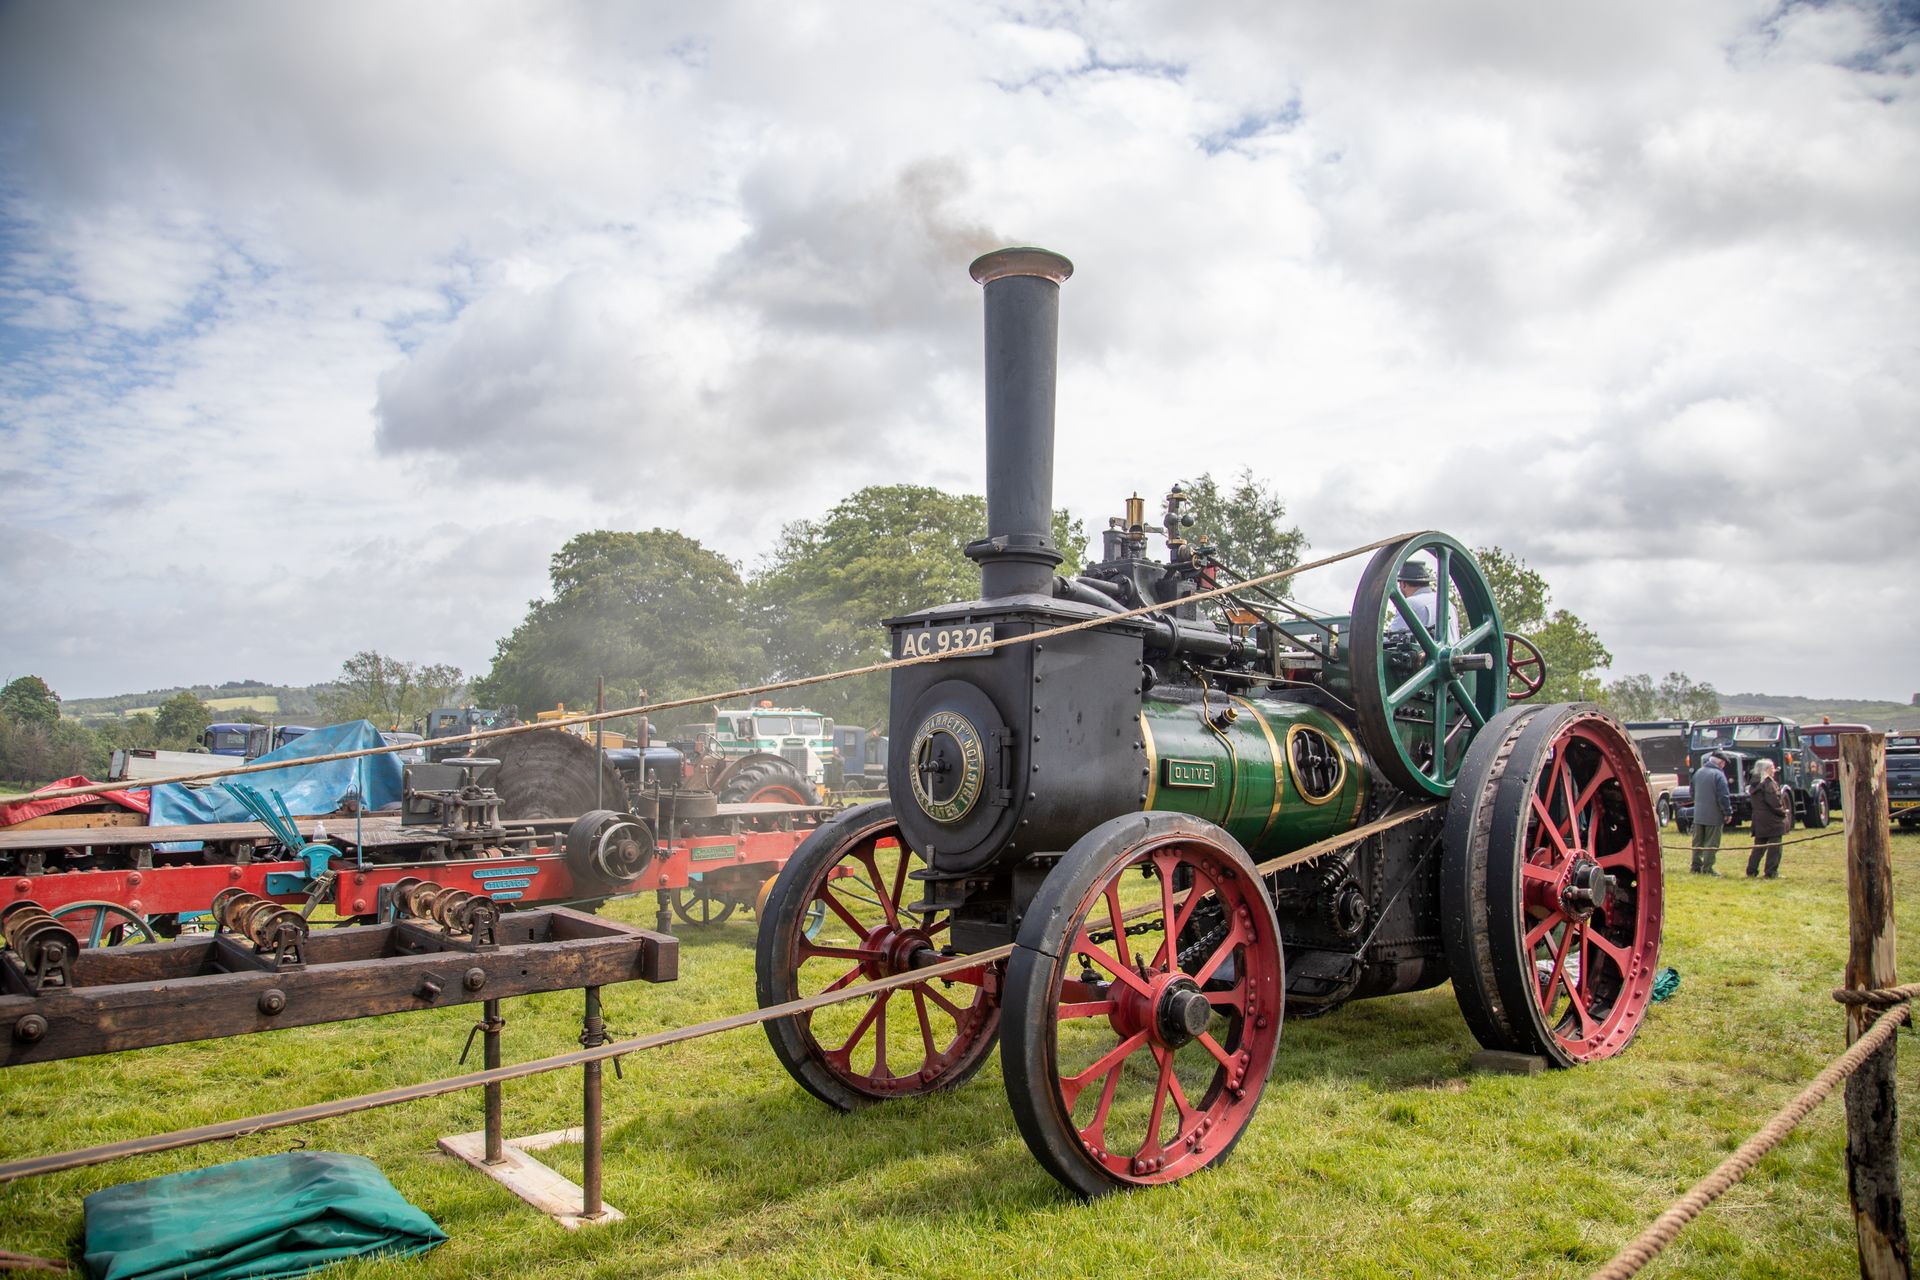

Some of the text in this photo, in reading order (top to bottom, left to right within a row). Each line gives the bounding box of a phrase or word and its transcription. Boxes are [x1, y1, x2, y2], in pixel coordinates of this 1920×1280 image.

[902, 626, 992, 657] AC 9326
[1708, 715, 1765, 725] CHERRY BLOSSOM
[1175, 766, 1210, 781] OLIVE
